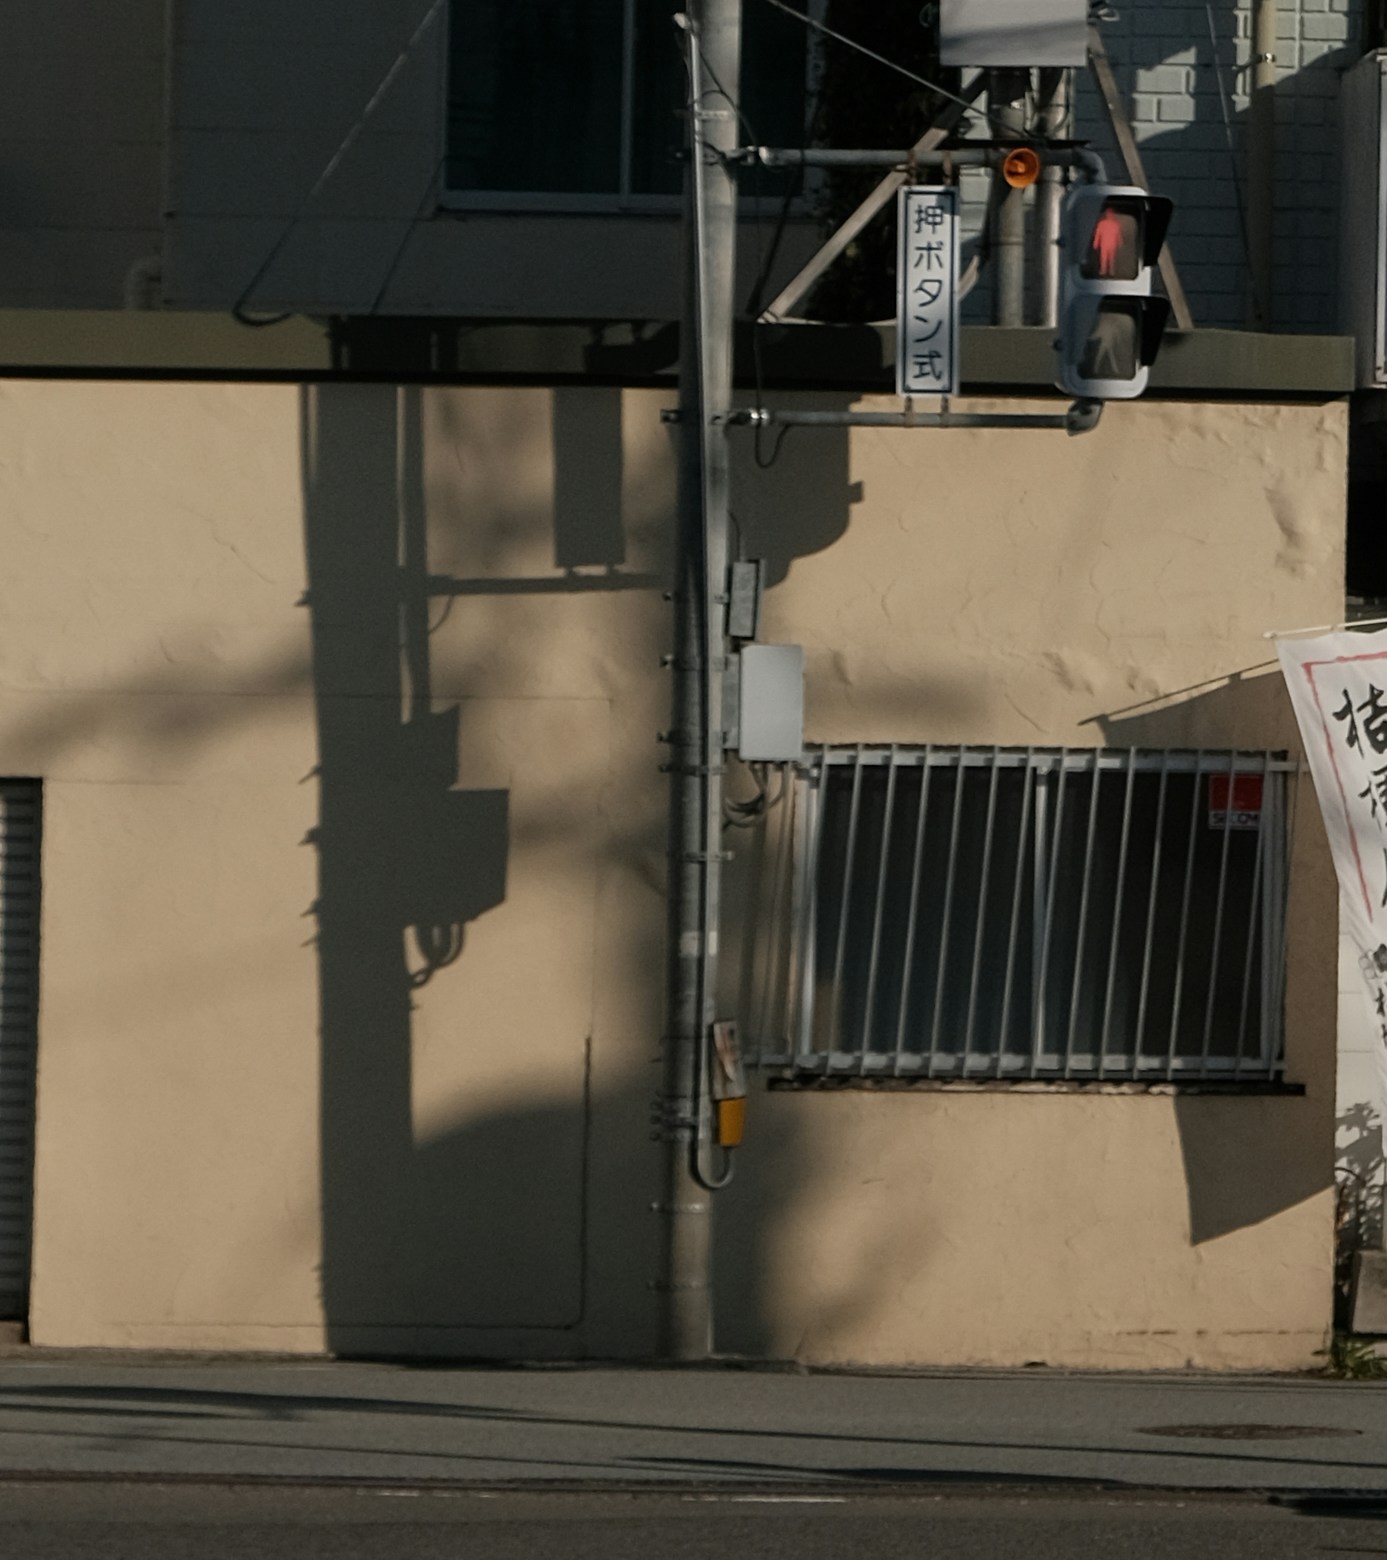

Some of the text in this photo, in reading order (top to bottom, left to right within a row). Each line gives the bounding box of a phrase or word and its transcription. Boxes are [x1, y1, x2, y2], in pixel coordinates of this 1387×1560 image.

[912, 203, 945, 382] 押ボタン式
